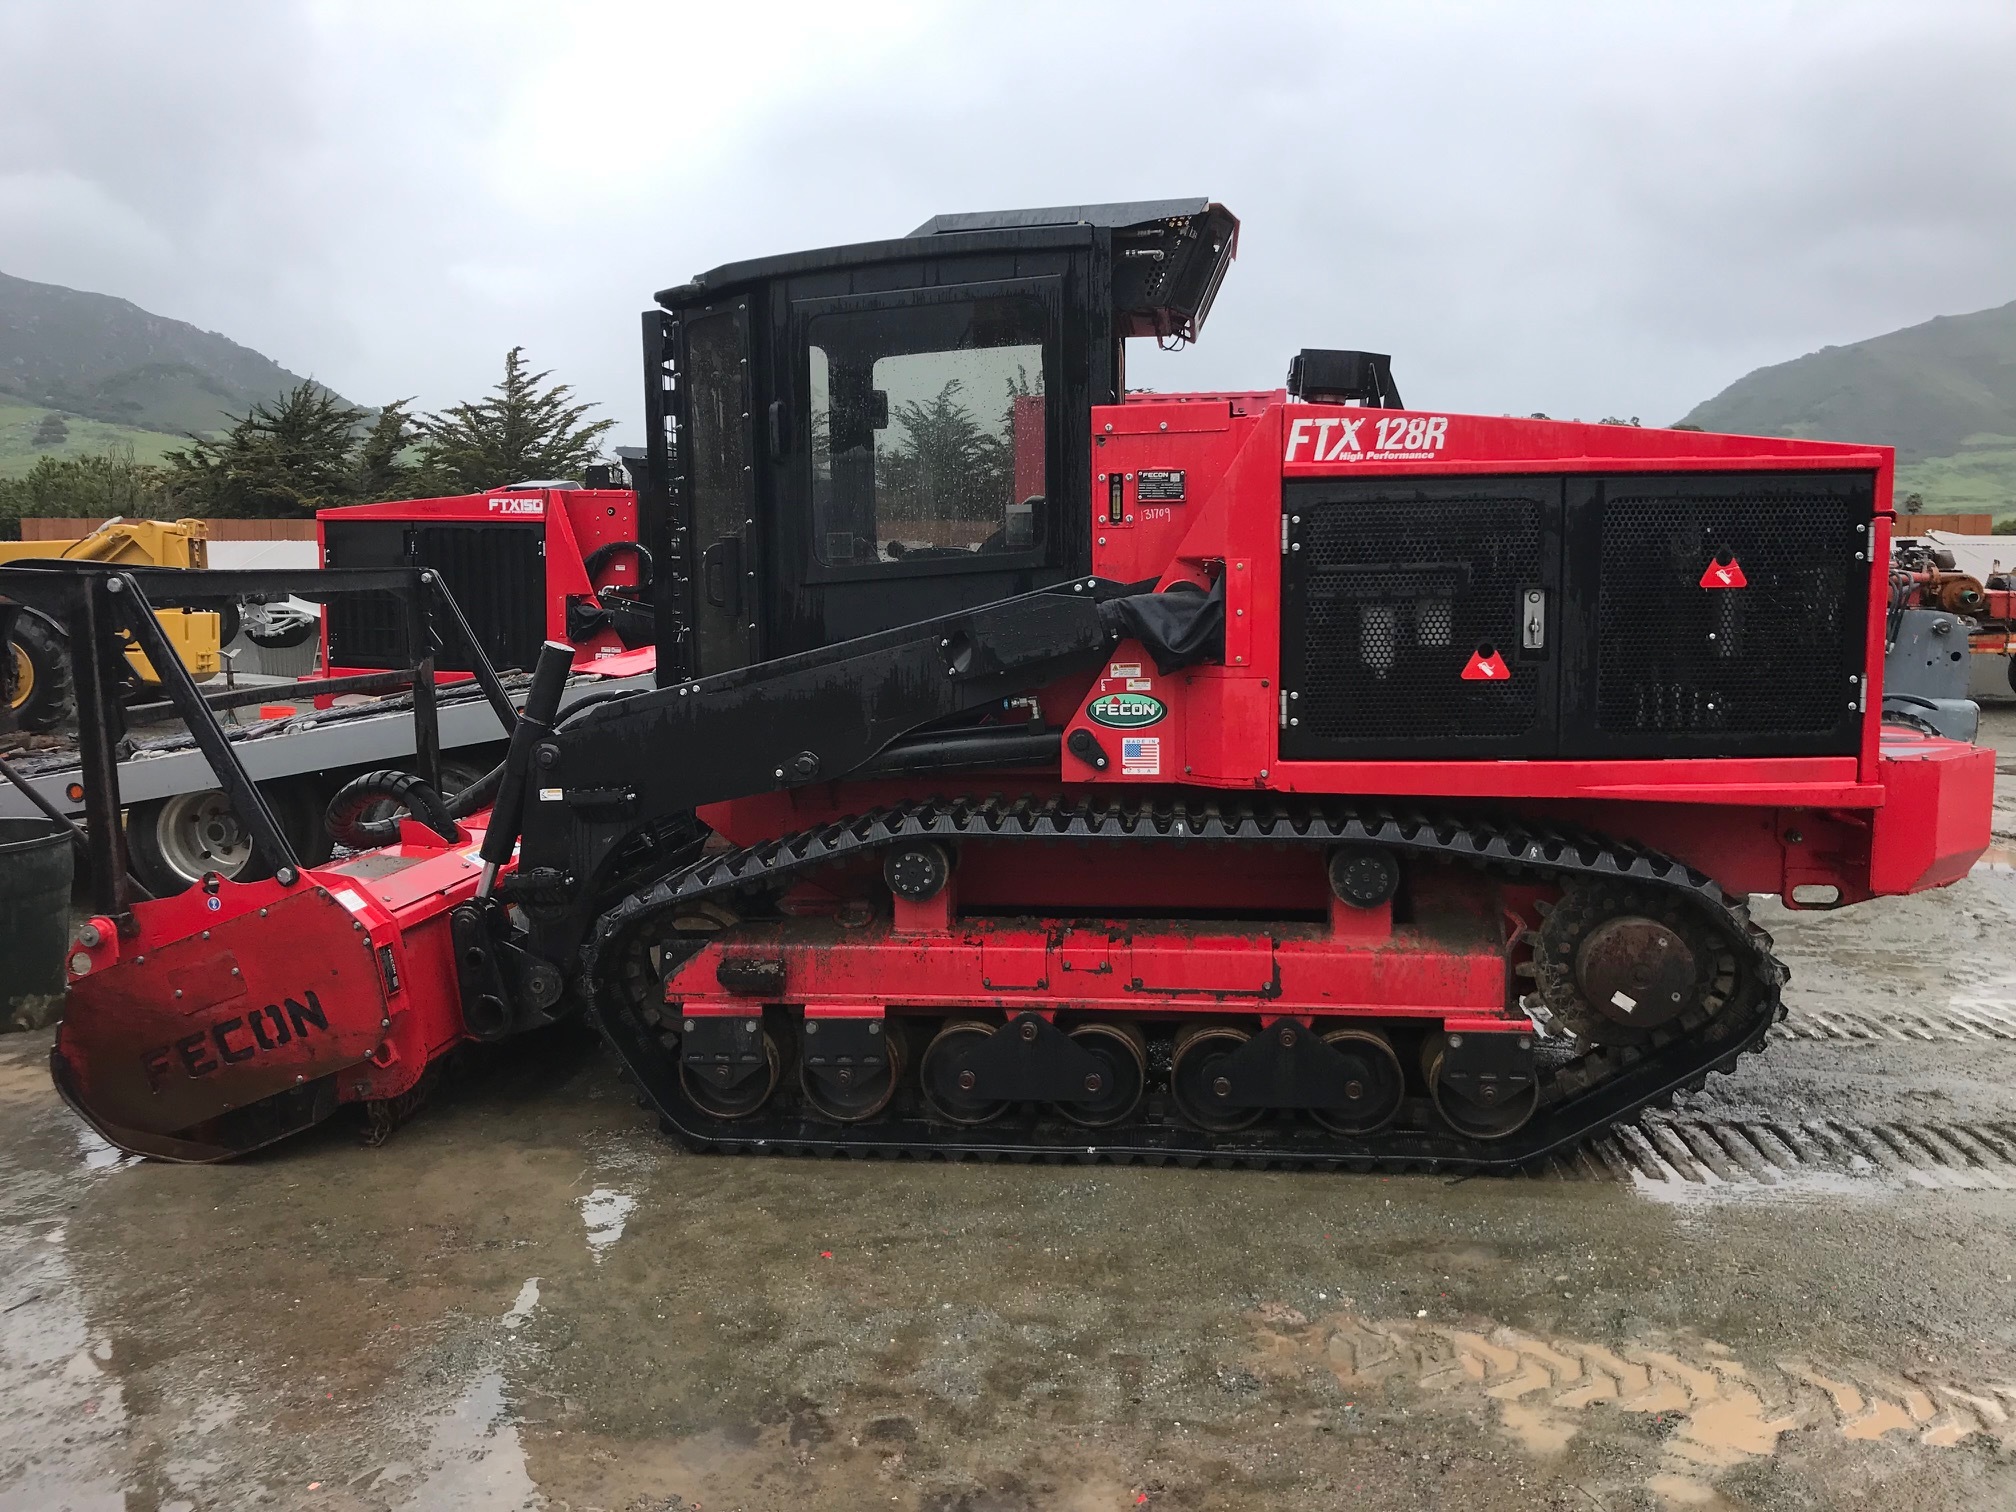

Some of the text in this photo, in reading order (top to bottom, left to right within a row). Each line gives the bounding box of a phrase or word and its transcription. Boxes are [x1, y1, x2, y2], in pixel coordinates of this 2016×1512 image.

[1284, 416, 1449, 462] FTX 128R
[1338, 450, 1435, 463] High Performance
[488, 498, 544, 511] FTX150
[1095, 703, 1155, 716] FECON
[140, 989, 329, 1094] FECON
